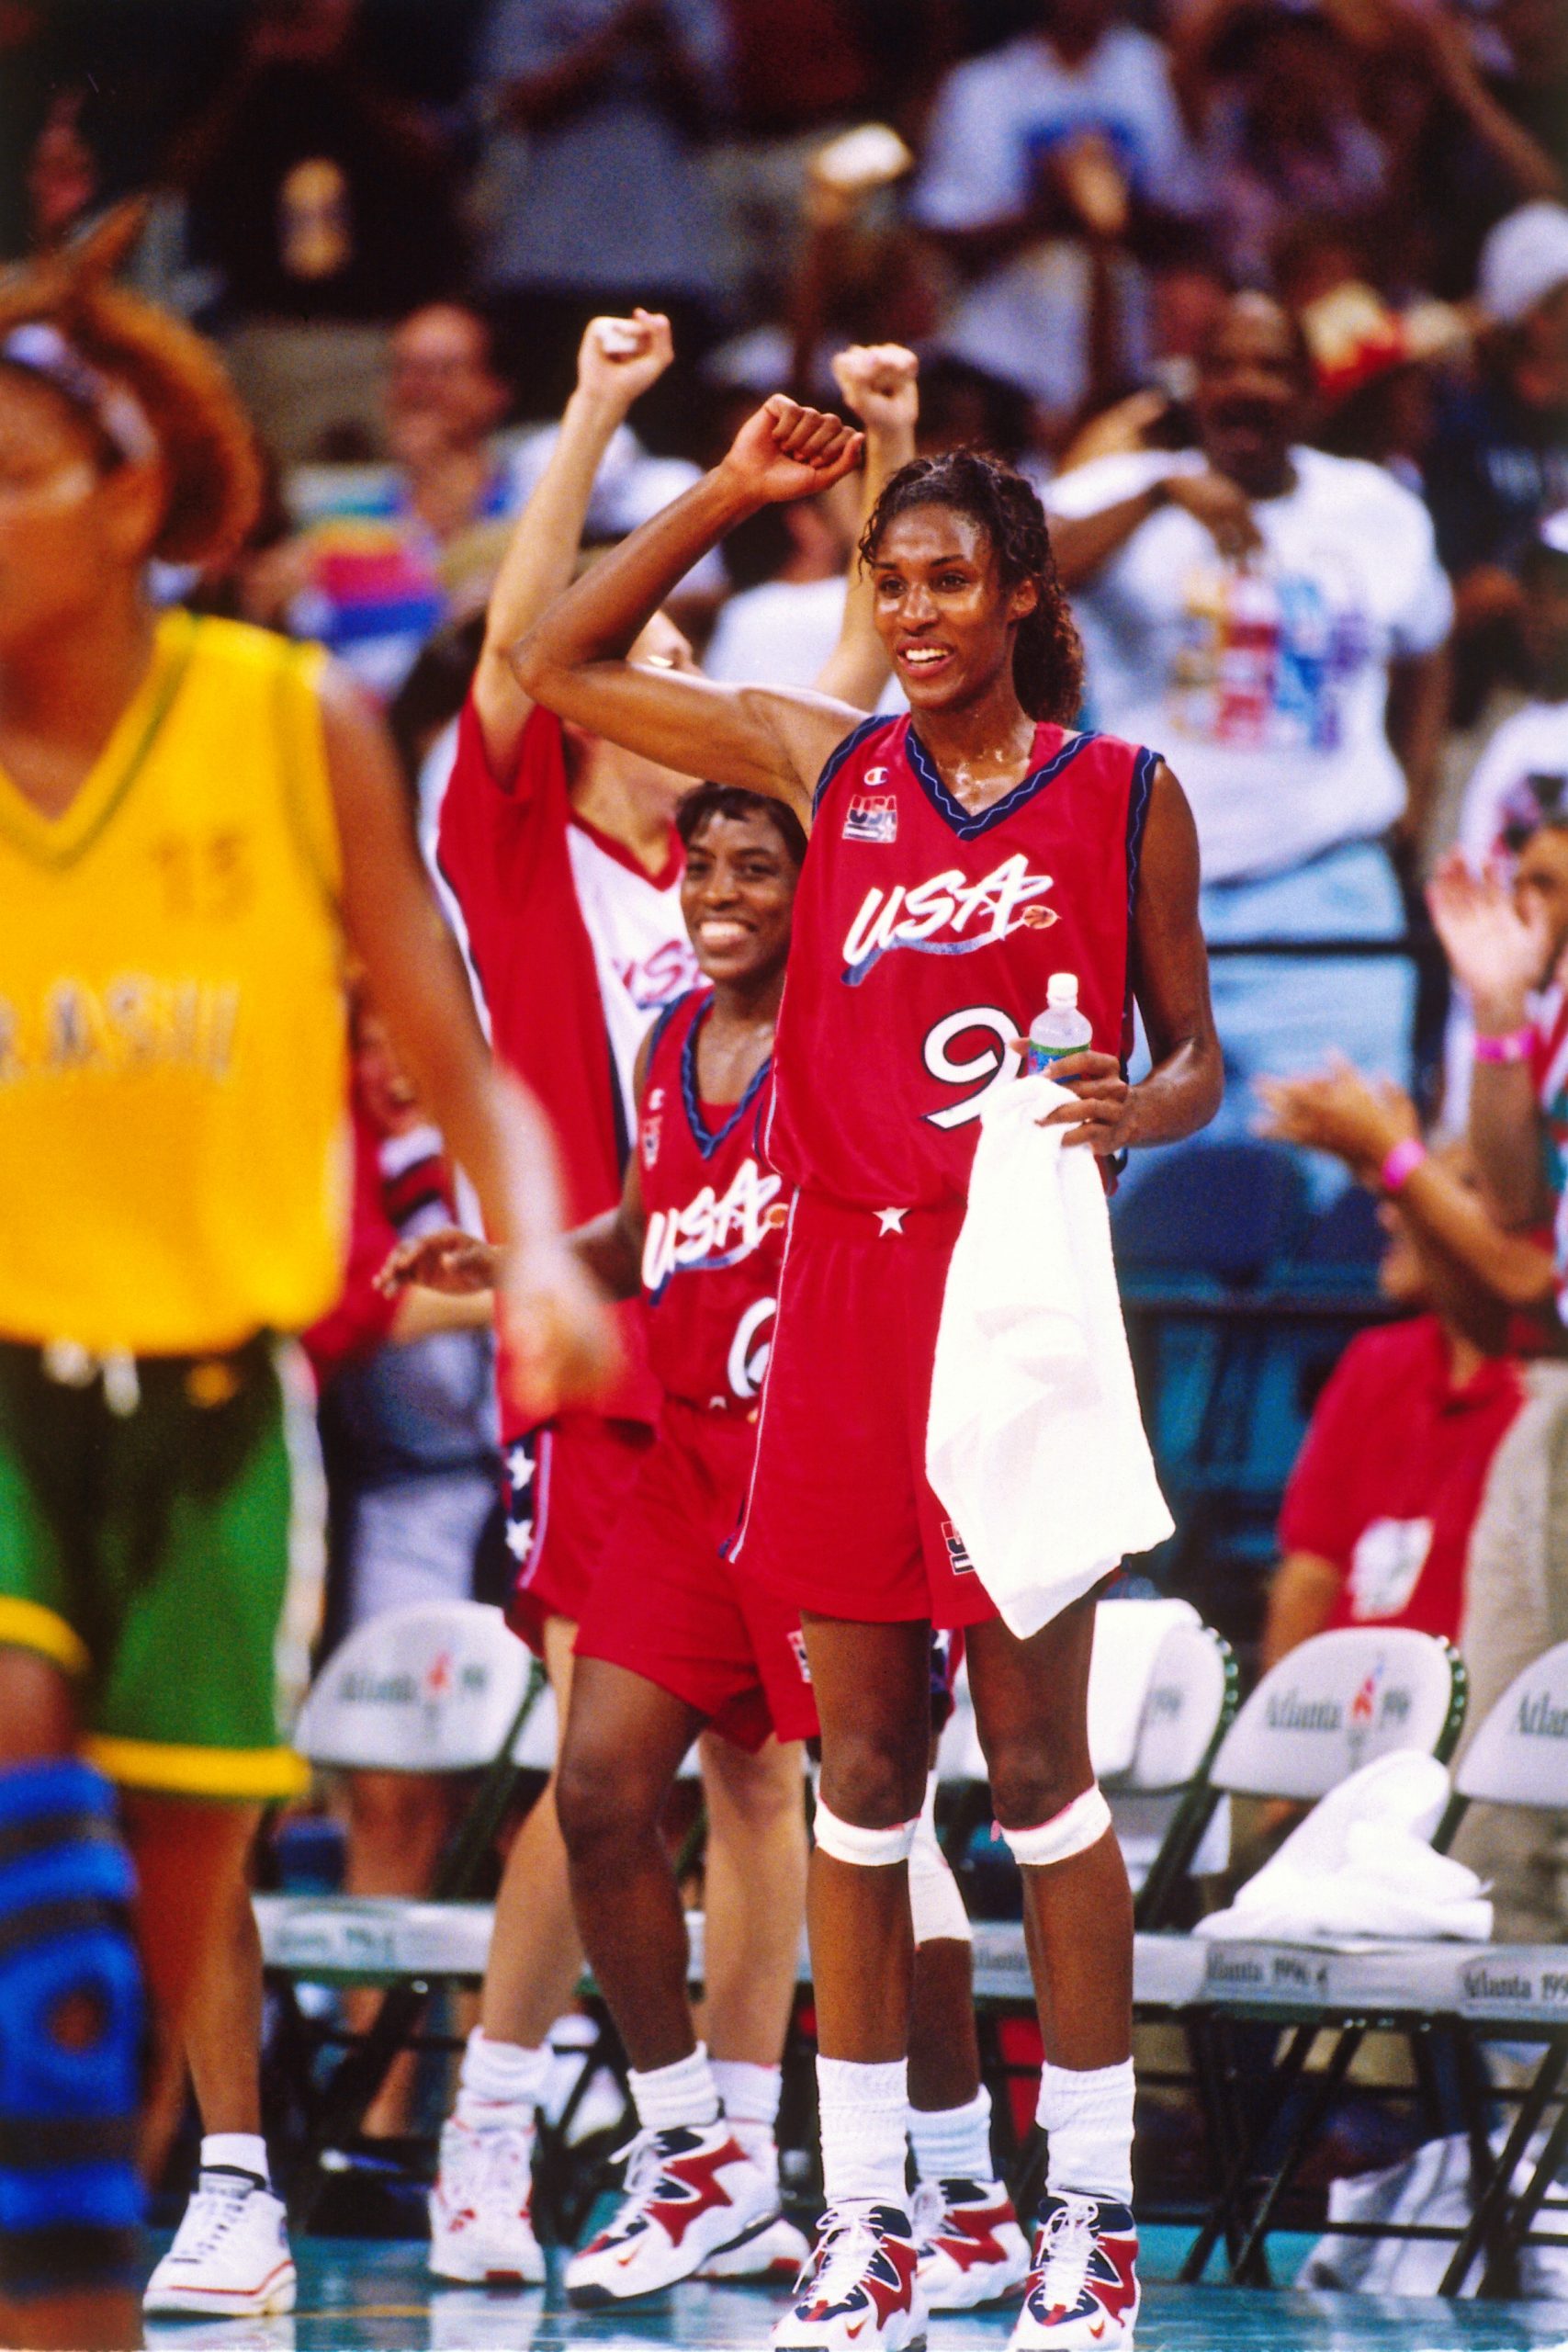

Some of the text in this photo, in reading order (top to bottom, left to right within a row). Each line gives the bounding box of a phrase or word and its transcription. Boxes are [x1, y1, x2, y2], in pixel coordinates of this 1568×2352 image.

[841, 853, 1055, 967] USA
[920, 1003, 1025, 1133] 9
[641, 1158, 782, 1292] USA
[1266, 1687, 1343, 1731] Atlanta
[1463, 1968, 1532, 2000] Atlanta
